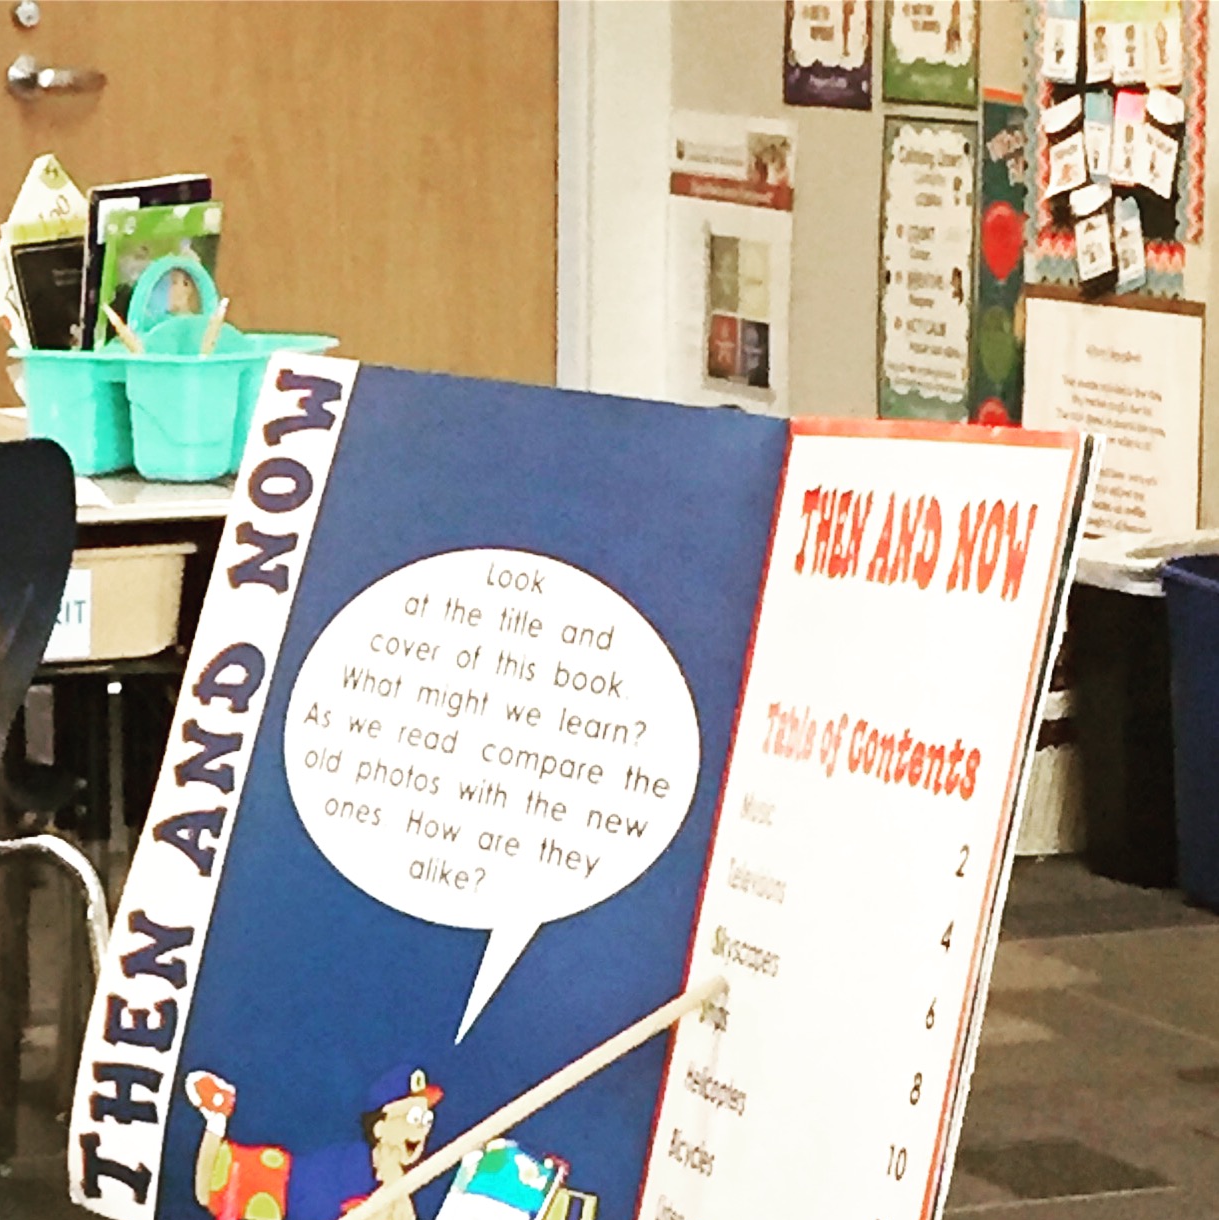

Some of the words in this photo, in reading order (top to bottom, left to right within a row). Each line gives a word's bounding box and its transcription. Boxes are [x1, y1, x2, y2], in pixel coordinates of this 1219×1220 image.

[794, 484, 873, 579] THEN
[866, 491, 942, 590] AND
[946, 499, 1038, 602] NOW
[486, 562, 546, 595] Look
[55, 600, 86, 625] IT
[404, 593, 430, 617] at
[444, 597, 482, 627] the
[499, 607, 543, 638] title
[561, 624, 615, 651] and
[370, 632, 441, 662] cover
[456, 645, 482, 670] of
[496, 650, 536, 682] this
[343, 665, 403, 698] What
[416, 685, 490, 718] might
[506, 703, 542, 728] we
[558, 707, 647, 748] learn?
[303, 702, 332, 729] As
[349, 717, 382, 739] we
[397, 725, 459, 754] read
[481, 743, 604, 785] compare
[624, 765, 671, 799] the
[763, 701, 817, 760] Table
[820, 713, 849, 778] of
[847, 718, 981, 801] Contents
[82, 909, 195, 1206] THEN
[153, 641, 267, 878] AND
[229, 368, 344, 597] NOW
[304, 748, 343, 773] old
[355, 760, 441, 796] photos
[459, 779, 508, 809] with
[525, 790, 567, 822] the
[586, 809, 649, 839] new
[406, 809, 462, 843] How
[478, 831, 520, 857] are
[539, 837, 601, 879] they
[954, 843, 970, 878] 2
[408, 857, 487, 892] alike?
[940, 920, 955, 953] 4
[925, 997, 937, 1030] 6
[909, 1072, 923, 1106] 8
[887, 1144, 908, 1181] 10
